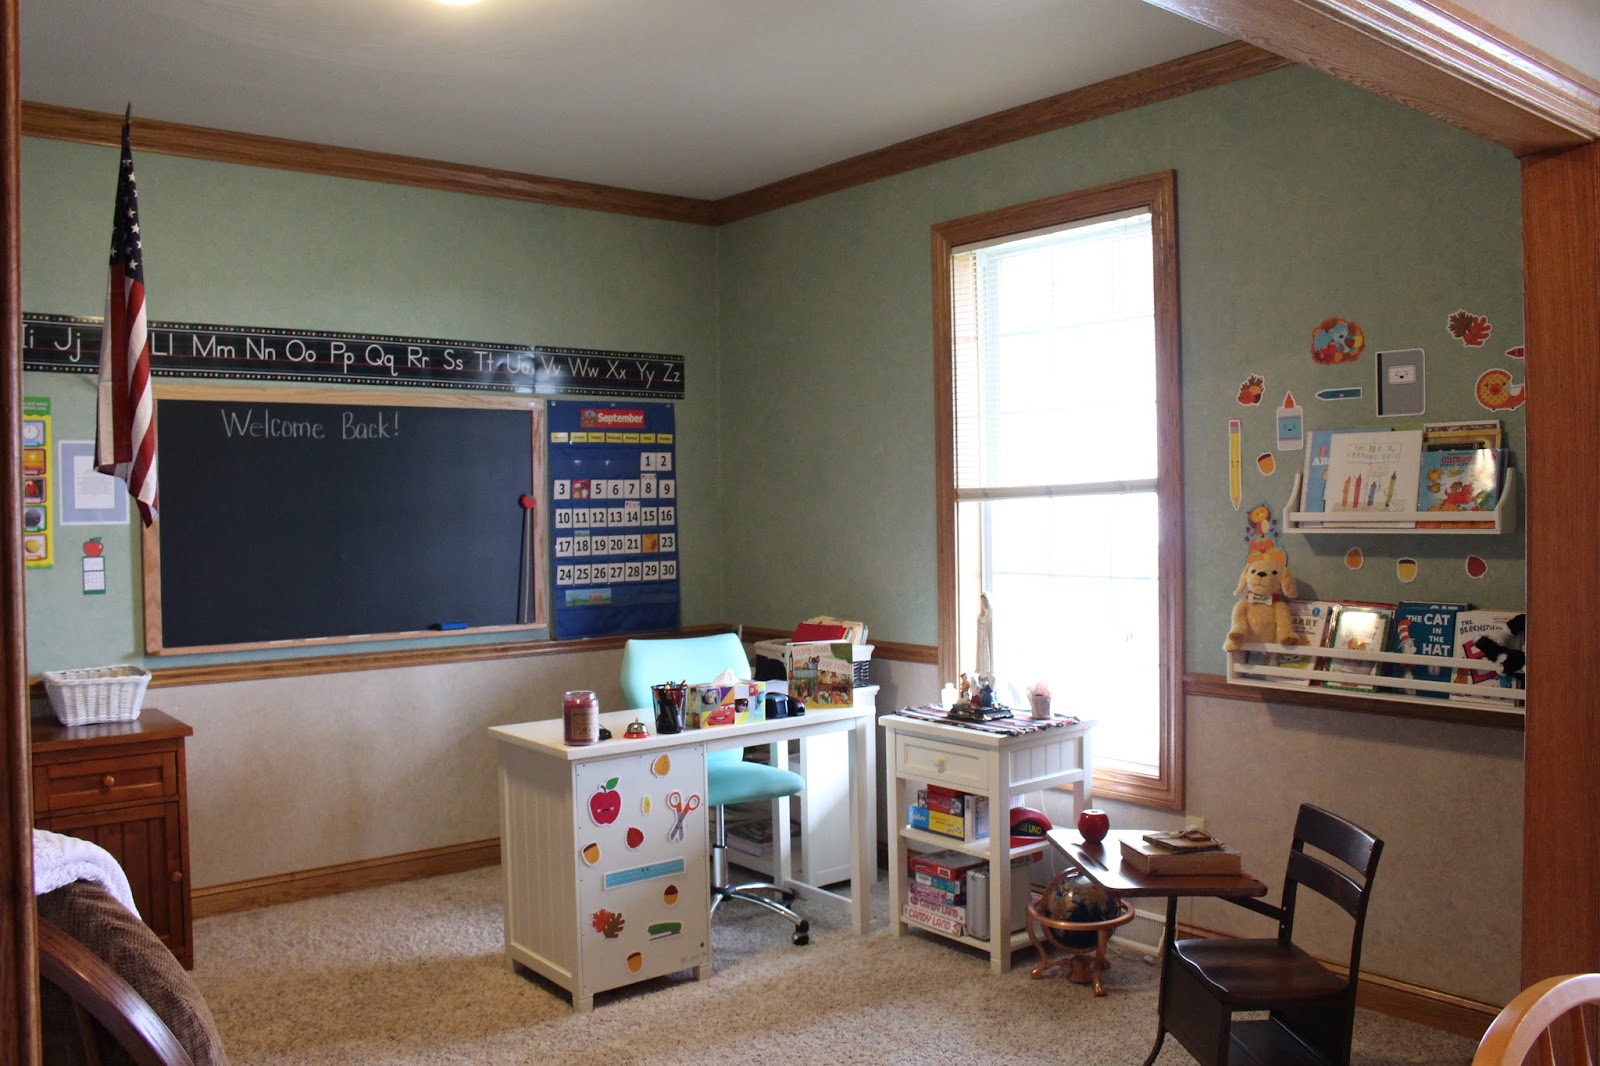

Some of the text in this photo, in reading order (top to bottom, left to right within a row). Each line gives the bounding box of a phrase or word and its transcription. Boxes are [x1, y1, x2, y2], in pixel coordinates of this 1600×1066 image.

[54, 327, 81, 362] Jj
[192, 334, 235, 359] Mm
[246, 338, 276, 361] Nn
[285, 339, 317, 363] Oo
[330, 341, 355, 374] Pp
[365, 344, 398, 377] Qq
[407, 346, 429, 368] Rr
[443, 349, 464, 371] Ss
[474, 351, 494, 372] Tt
[506, 353, 530, 374] Uu
[541, 355, 561, 376] Vv
[568, 357, 599, 378] Ww
[605, 359, 627, 380] Xx
[635, 361, 655, 389] Yy
[663, 363, 680, 383] Zz
[220, 408, 399, 440] Welcome Back!
[597, 412, 644, 425] September
[646, 456, 667, 467] 1 2
[1312, 457, 1329, 466] AB
[559, 482, 670, 496] 3 5 6 7 8 9
[558, 510, 673, 524] 10 11 12 13 14 15 16
[559, 537, 673, 552] 17 18 19 20 21 23
[559, 564, 675, 581] 24 25 26 27 28 29 30
[1406, 613, 1450, 626] THE CAT
[1461, 619, 1473, 627] THE
[1429, 635, 1444, 643] THE
[1422, 643, 1451, 656] HAT
[1029, 824, 1042, 835] UNO
[920, 898, 959, 919] CANDY LAND
[908, 908, 951, 931] CANDY LAND
